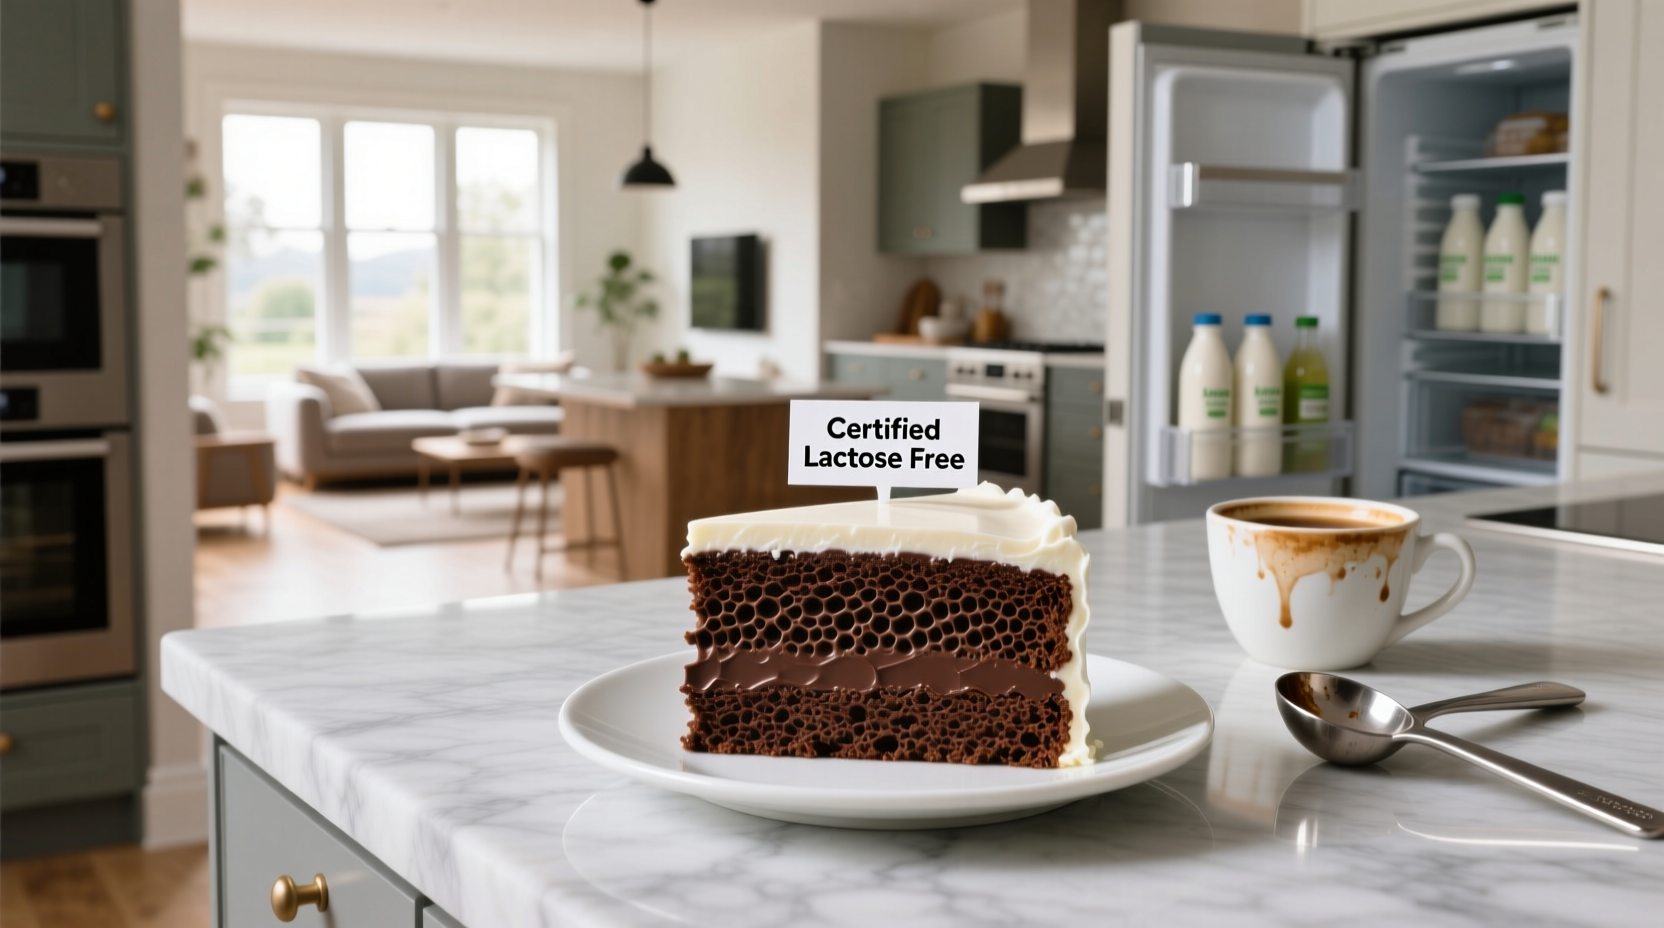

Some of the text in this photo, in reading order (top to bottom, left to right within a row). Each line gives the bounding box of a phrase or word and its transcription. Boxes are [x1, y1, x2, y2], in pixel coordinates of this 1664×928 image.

[826, 416, 941, 440] Certified
[804, 445, 965, 470] Lactose Free
